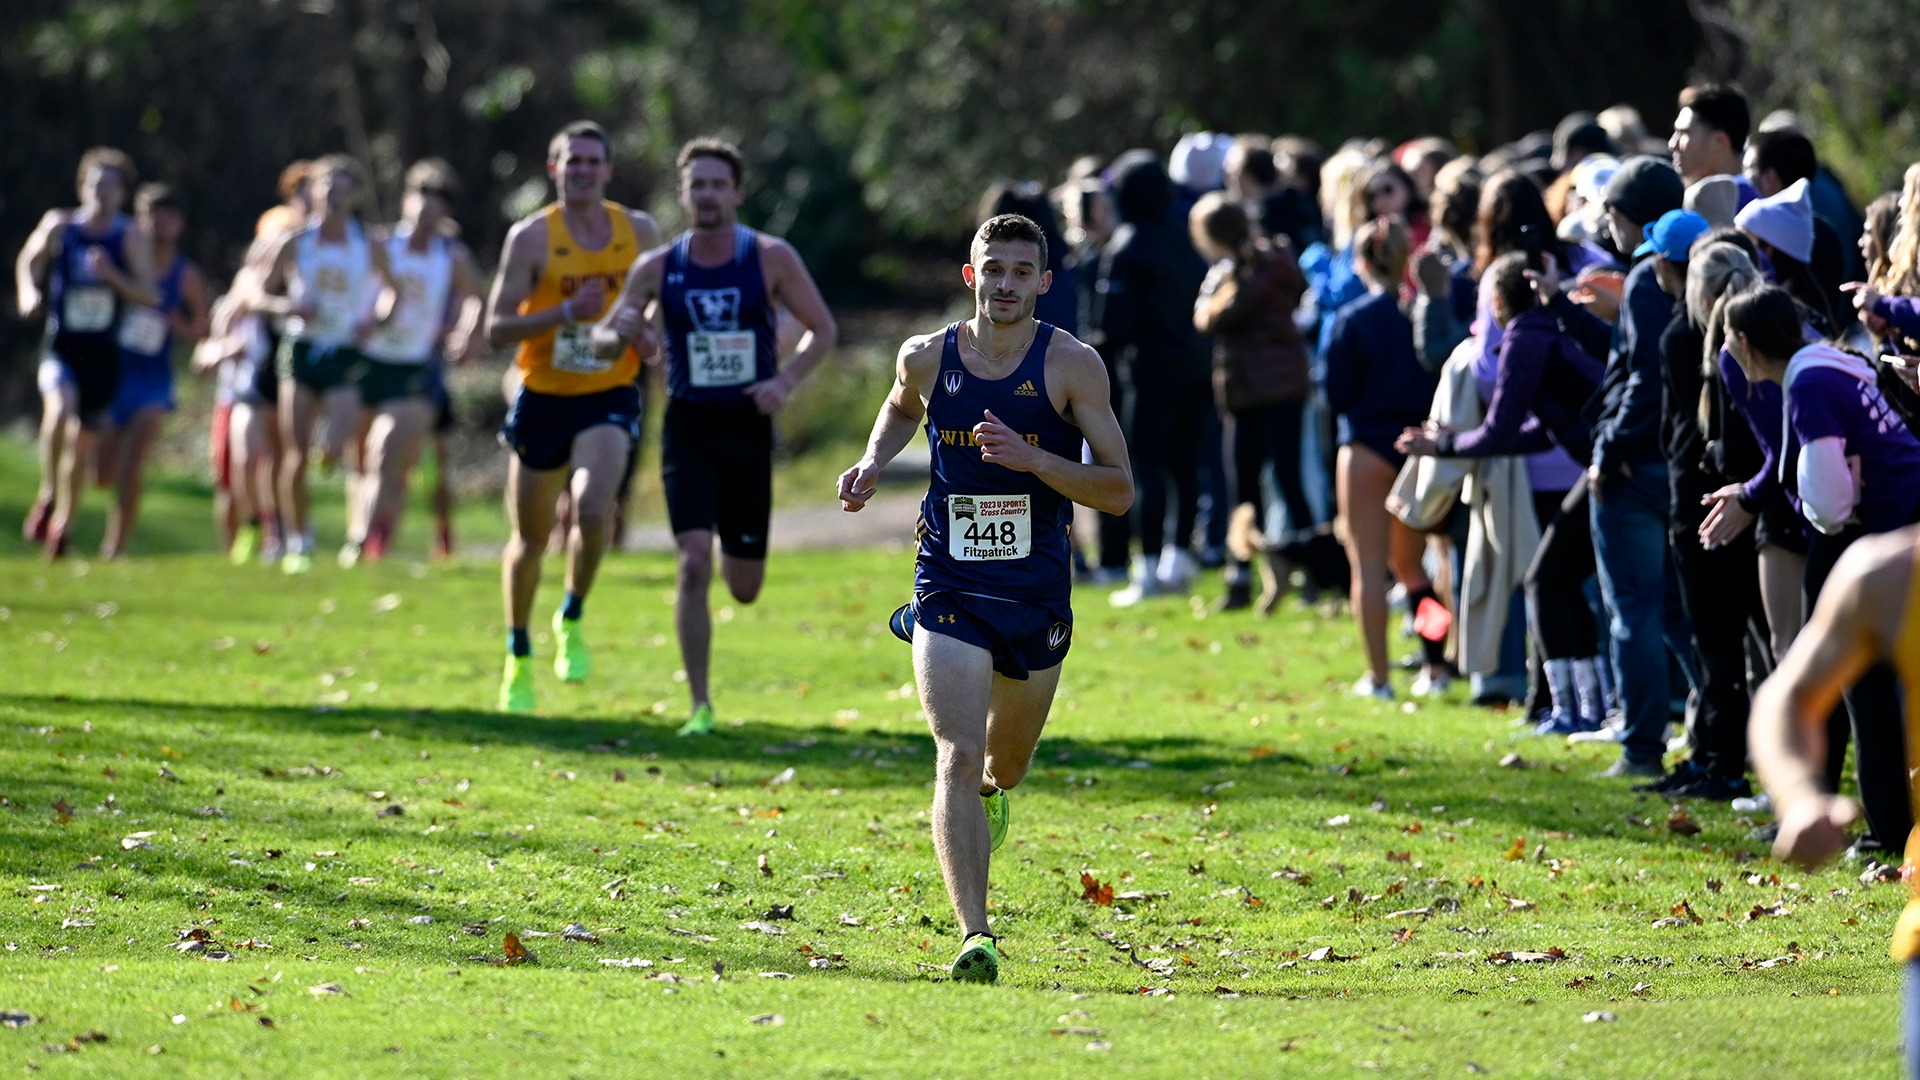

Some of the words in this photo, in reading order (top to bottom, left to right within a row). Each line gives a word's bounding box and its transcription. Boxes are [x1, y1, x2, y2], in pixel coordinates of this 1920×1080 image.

[701, 353, 744, 373] 446
[1014, 389, 1038, 397] adidas
[940, 429, 1040, 448] WINR
[980, 501, 996, 509] 2023
[1000, 507, 1027, 516] Country
[964, 521, 1016, 546] 448
[964, 546, 1018, 559] Fitzpatrick
